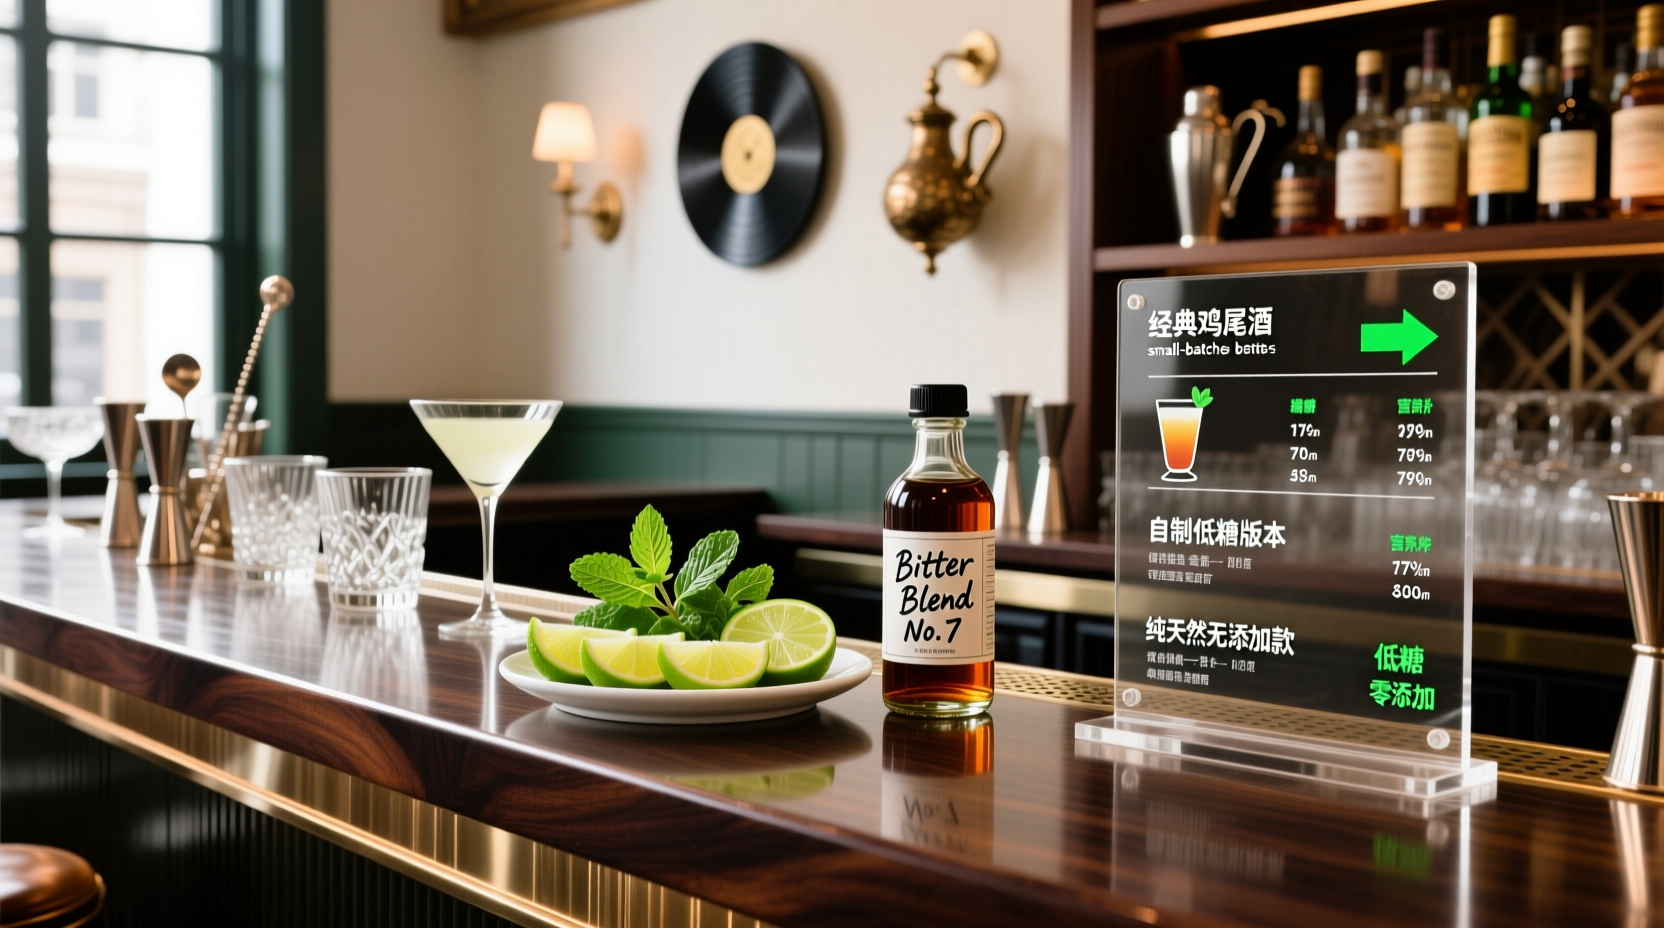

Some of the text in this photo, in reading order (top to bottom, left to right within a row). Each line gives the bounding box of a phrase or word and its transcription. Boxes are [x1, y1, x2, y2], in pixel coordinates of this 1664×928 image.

[1148, 306, 1273, 338] 经典鸡尾酒
[1149, 516, 1286, 549] 自制低糖版本
[894, 547, 974, 583] Bitter
[898, 575, 974, 616] Blend
[1145, 616, 1295, 656] 纯天然无添加款
[1374, 643, 1425, 675] 低糖
[1369, 679, 1436, 711] 零添加
